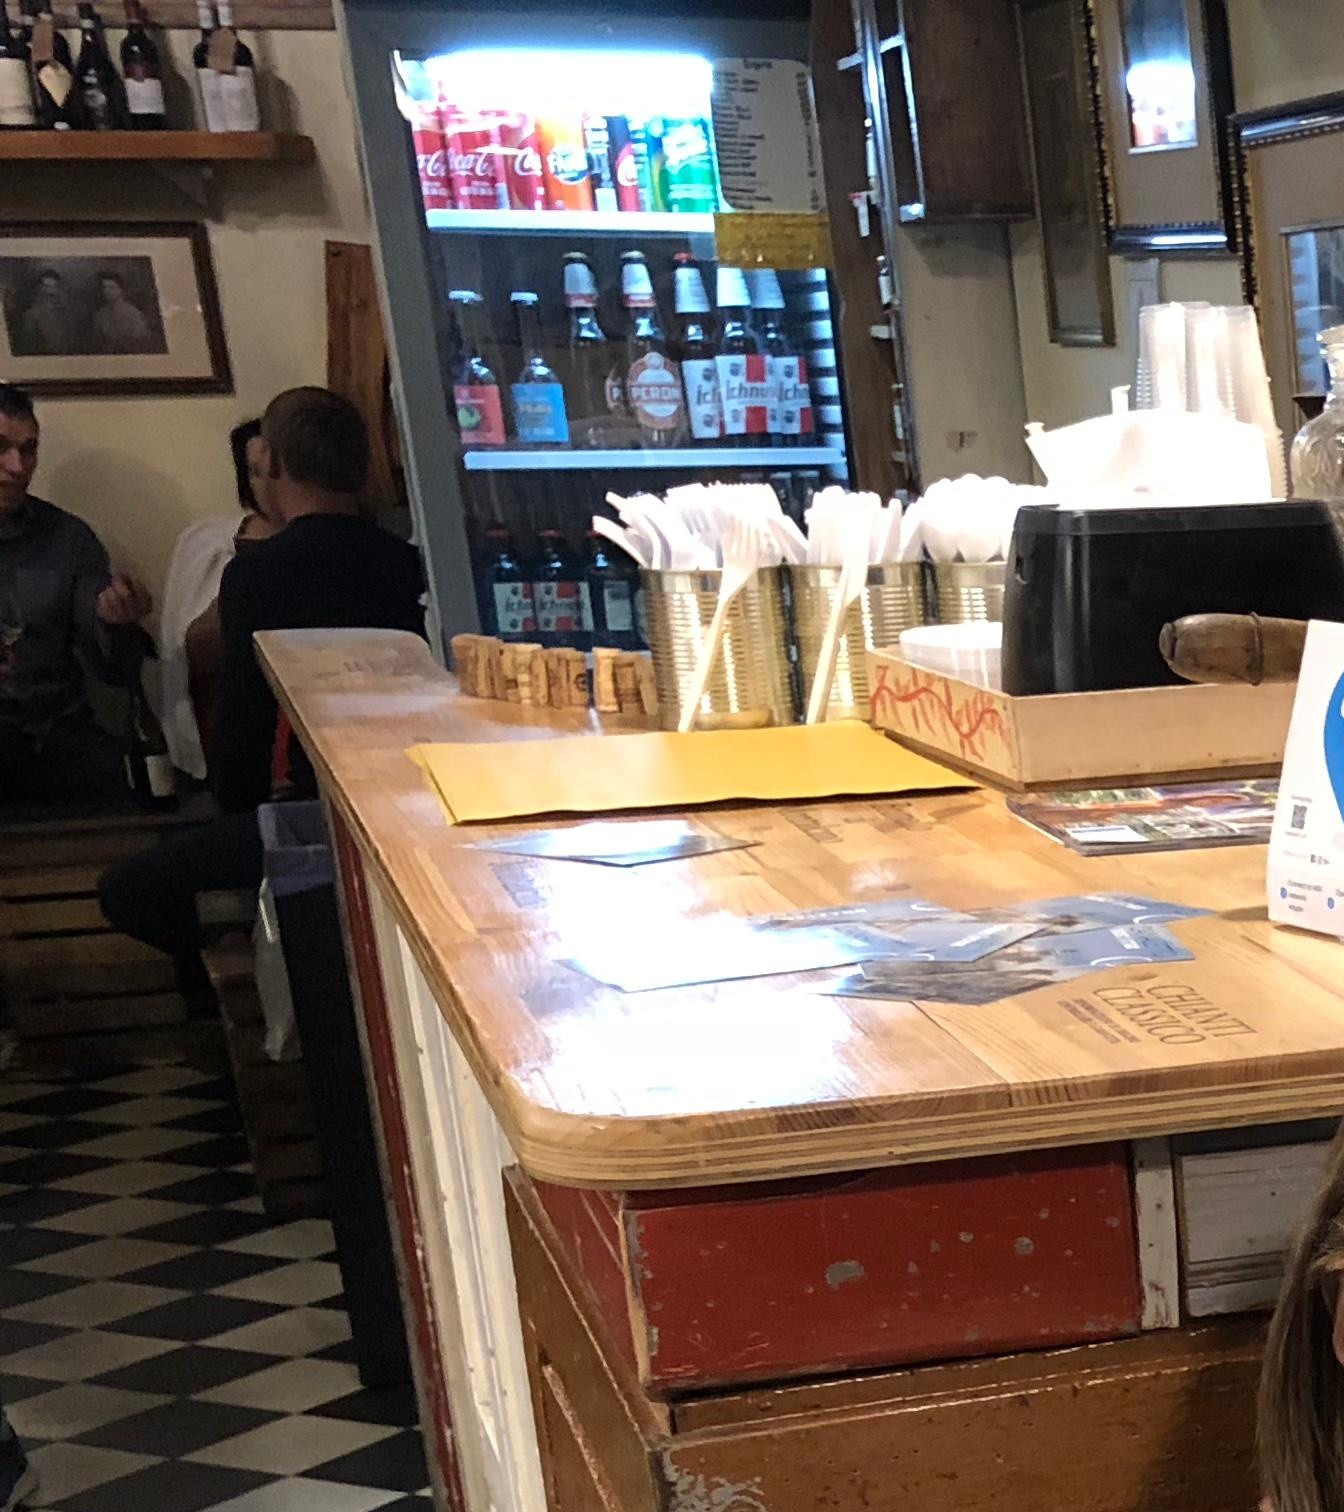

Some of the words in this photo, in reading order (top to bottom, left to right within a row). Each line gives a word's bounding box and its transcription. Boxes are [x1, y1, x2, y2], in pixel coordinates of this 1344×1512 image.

[631, 386, 680, 401] PERON
[1093, 987, 1206, 1044] CLASSICO
[1147, 984, 1258, 1037] CHIANTI
